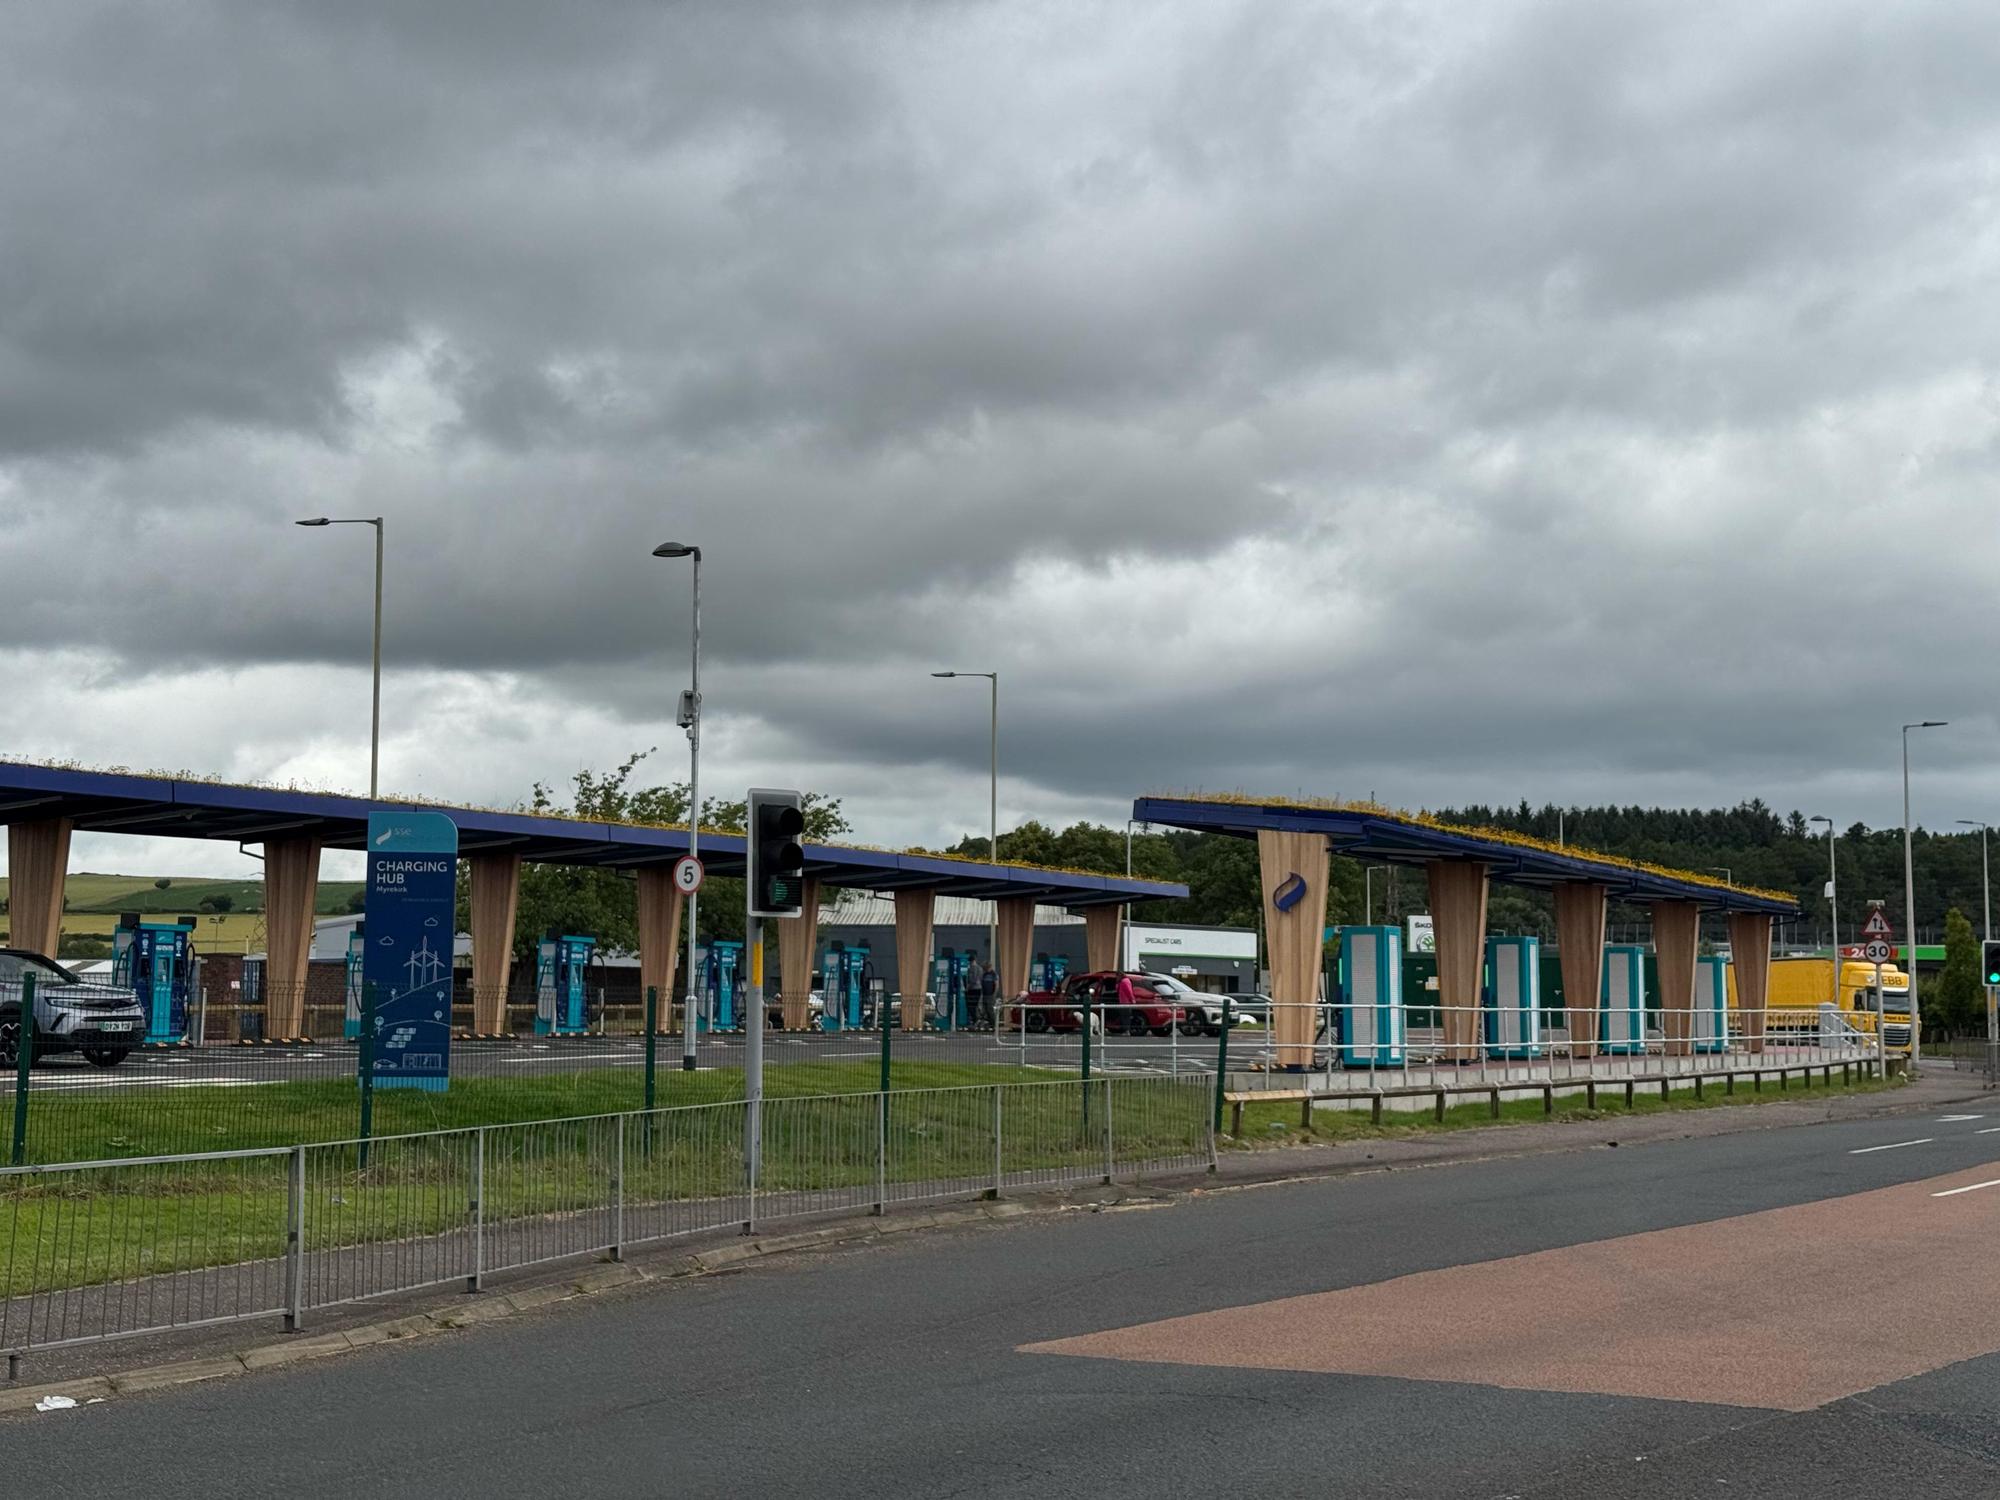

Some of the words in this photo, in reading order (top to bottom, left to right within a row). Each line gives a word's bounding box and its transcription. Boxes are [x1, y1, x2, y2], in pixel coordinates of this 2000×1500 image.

[376, 861, 448, 872] CHARGING
[376, 873, 405, 884] HUB
[683, 866, 694, 884] 5
[1868, 945, 1889, 957] 30
[1880, 975, 1903, 986] EBB
